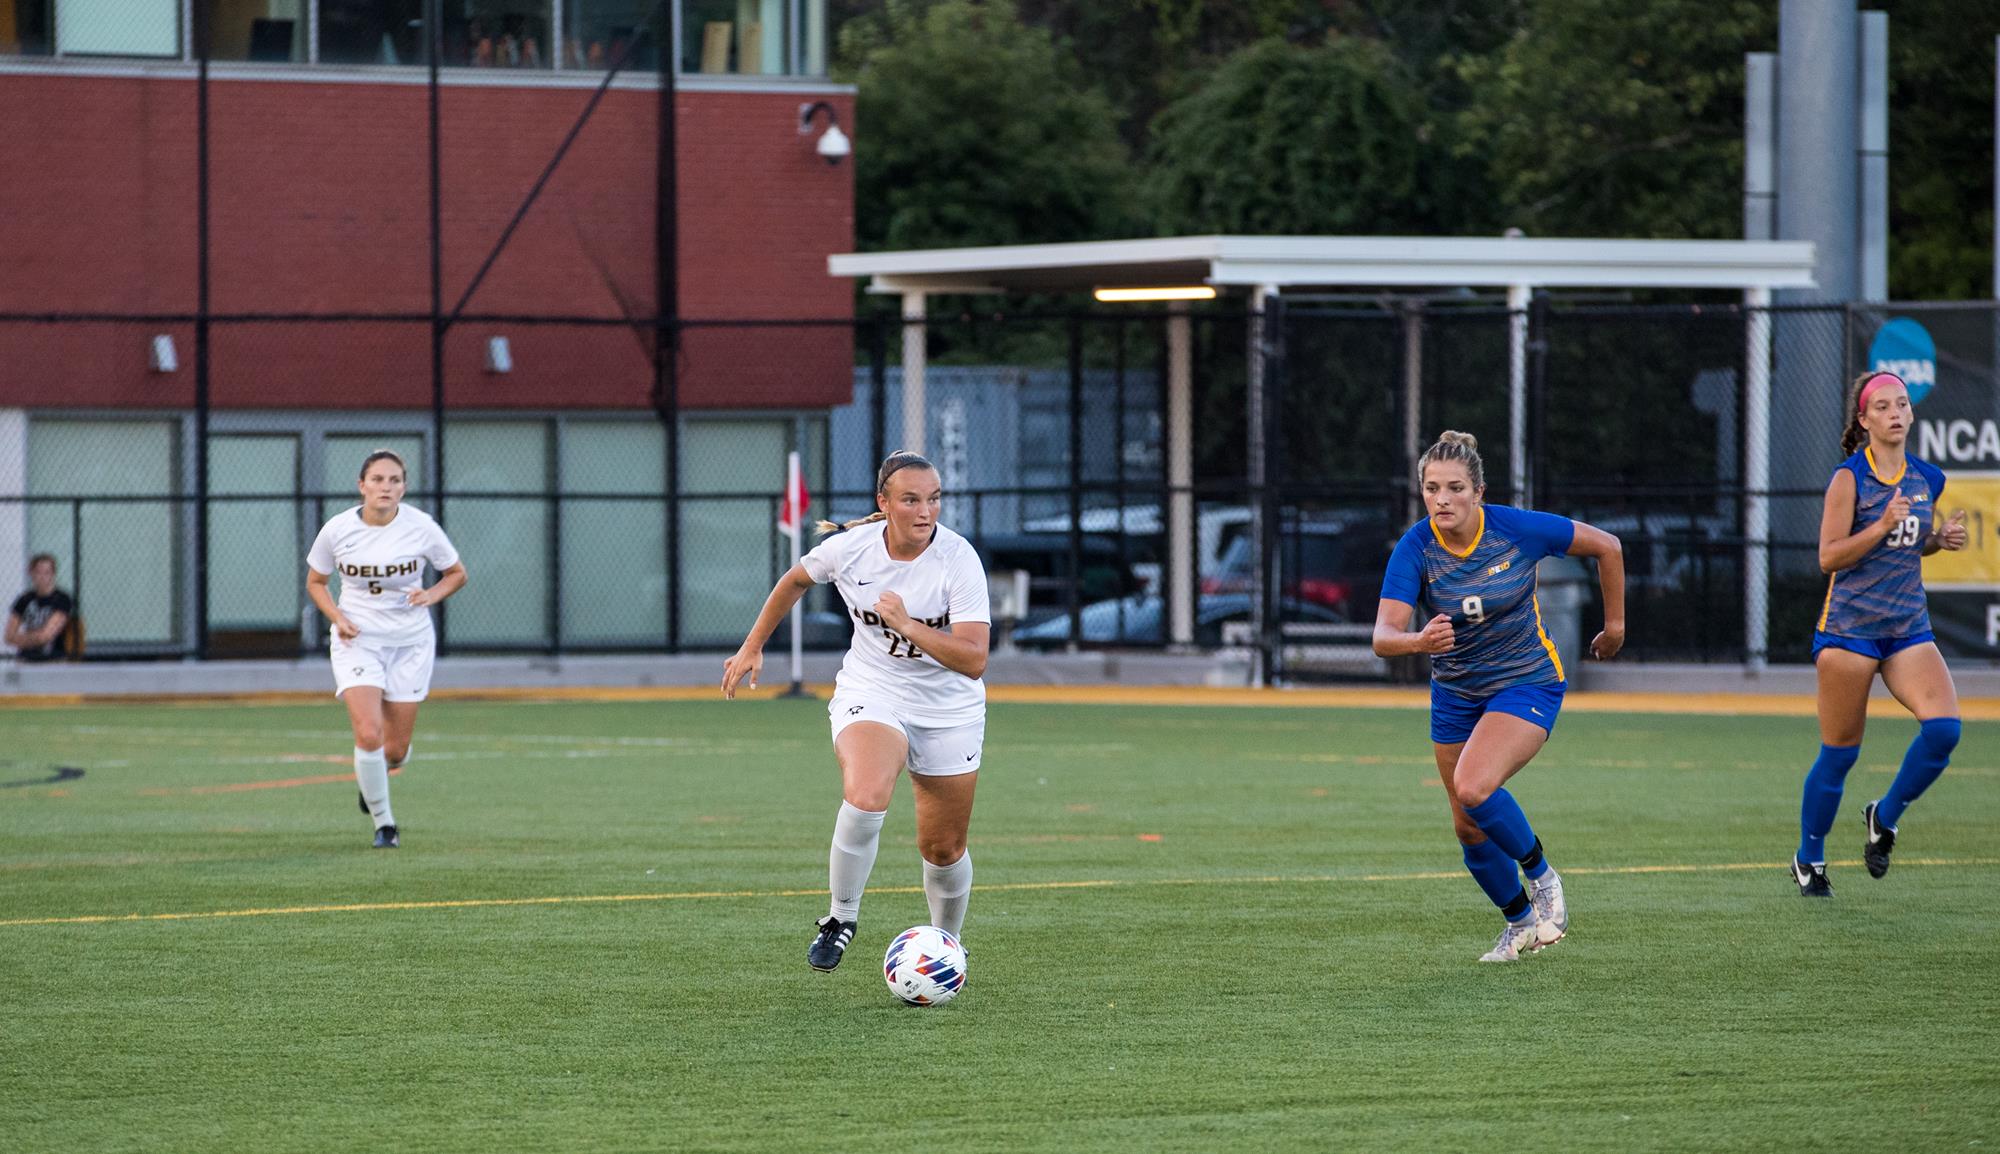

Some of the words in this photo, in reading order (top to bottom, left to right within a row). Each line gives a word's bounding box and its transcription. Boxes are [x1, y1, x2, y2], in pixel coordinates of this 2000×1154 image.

[337, 559, 418, 578] ADELPHI
[368, 581, 383, 595] 5
[1462, 595, 1485, 624] 9
